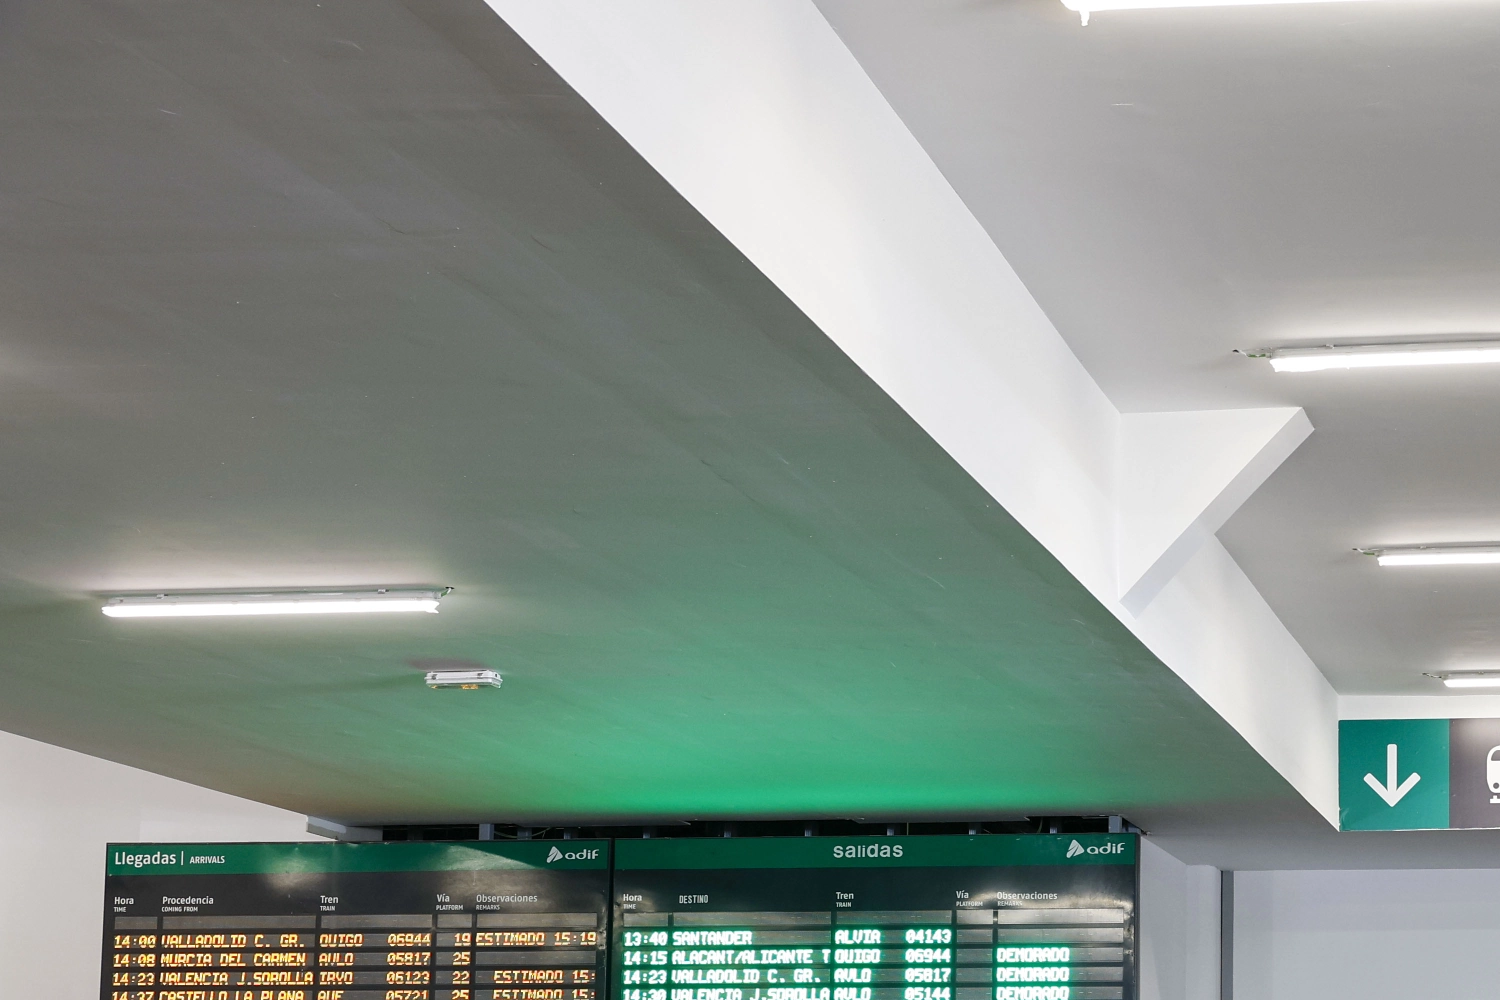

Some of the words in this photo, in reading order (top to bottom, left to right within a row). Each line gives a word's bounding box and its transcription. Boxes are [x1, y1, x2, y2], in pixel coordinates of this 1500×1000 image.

[564, 848, 600, 860] adif
[833, 843, 904, 858] salidas
[1086, 842, 1126, 855] adif
[115, 852, 176, 867] Llegadas
[190, 856, 225, 864] ARRIVALS
[114, 896, 134, 905] Hora
[162, 896, 214, 905] Procedencia
[320, 895, 339, 904] Tren
[436, 894, 450, 903] Vía
[476, 893, 538, 903] Observaciones
[623, 893, 642, 902] Hora
[679, 894, 709, 904] DESTINO
[836, 892, 854, 900] Tren
[956, 890, 969, 899] Vía
[996, 891, 1058, 901] Observaciones
[114, 934, 157, 948] 14:00
[161, 934, 247, 948] VALLADOLID
[254, 934, 271, 948] C.
[280, 934, 306, 948] GR.
[319, 934, 364, 947] OUIGO
[454, 932, 471, 946] 19
[476, 932, 545, 946] ESTIMADO
[554, 932, 598, 945] 15:19
[624, 932, 668, 946] 13:40
[672, 931, 753, 946] SANTANDER
[834, 929, 881, 944] ALVIA
[905, 929, 952, 944] 04143
[113, 953, 156, 967] 14:08
[160, 953, 213, 967] MURCIA
[220, 952, 246, 966] DEL
[254, 952, 306, 966] CARMEN
[318, 952, 354, 966] AVLO
[386, 952, 431, 966] 05817
[452, 952, 471, 966] 25
[623, 951, 668, 966] 14:15
[672, 950, 813, 964] ALACANT/ALICANTE
[822, 950, 831, 964] T
[834, 949, 880, 963] OUIGO
[905, 948, 951, 963] 06944
[996, 947, 1070, 962] DEMORADO
[112, 972, 155, 986] 14:23
[160, 972, 229, 986] VALENCIA
[236, 972, 314, 986] J.SOROLLA
[319, 971, 354, 984] IRYO
[452, 971, 470, 984] 22
[494, 970, 564, 984] ESTIMADO
[572, 970, 596, 983] 15:
[623, 970, 667, 984] 14:23
[671, 969, 760, 984] VALLADOLID
[767, 969, 786, 984] C.
[793, 968, 822, 984] GR.
[834, 968, 872, 982] AVLO
[904, 968, 951, 982] 05817
[996, 967, 1070, 982] DEMORADO
[996, 986, 1070, 1000] DEMORADO
